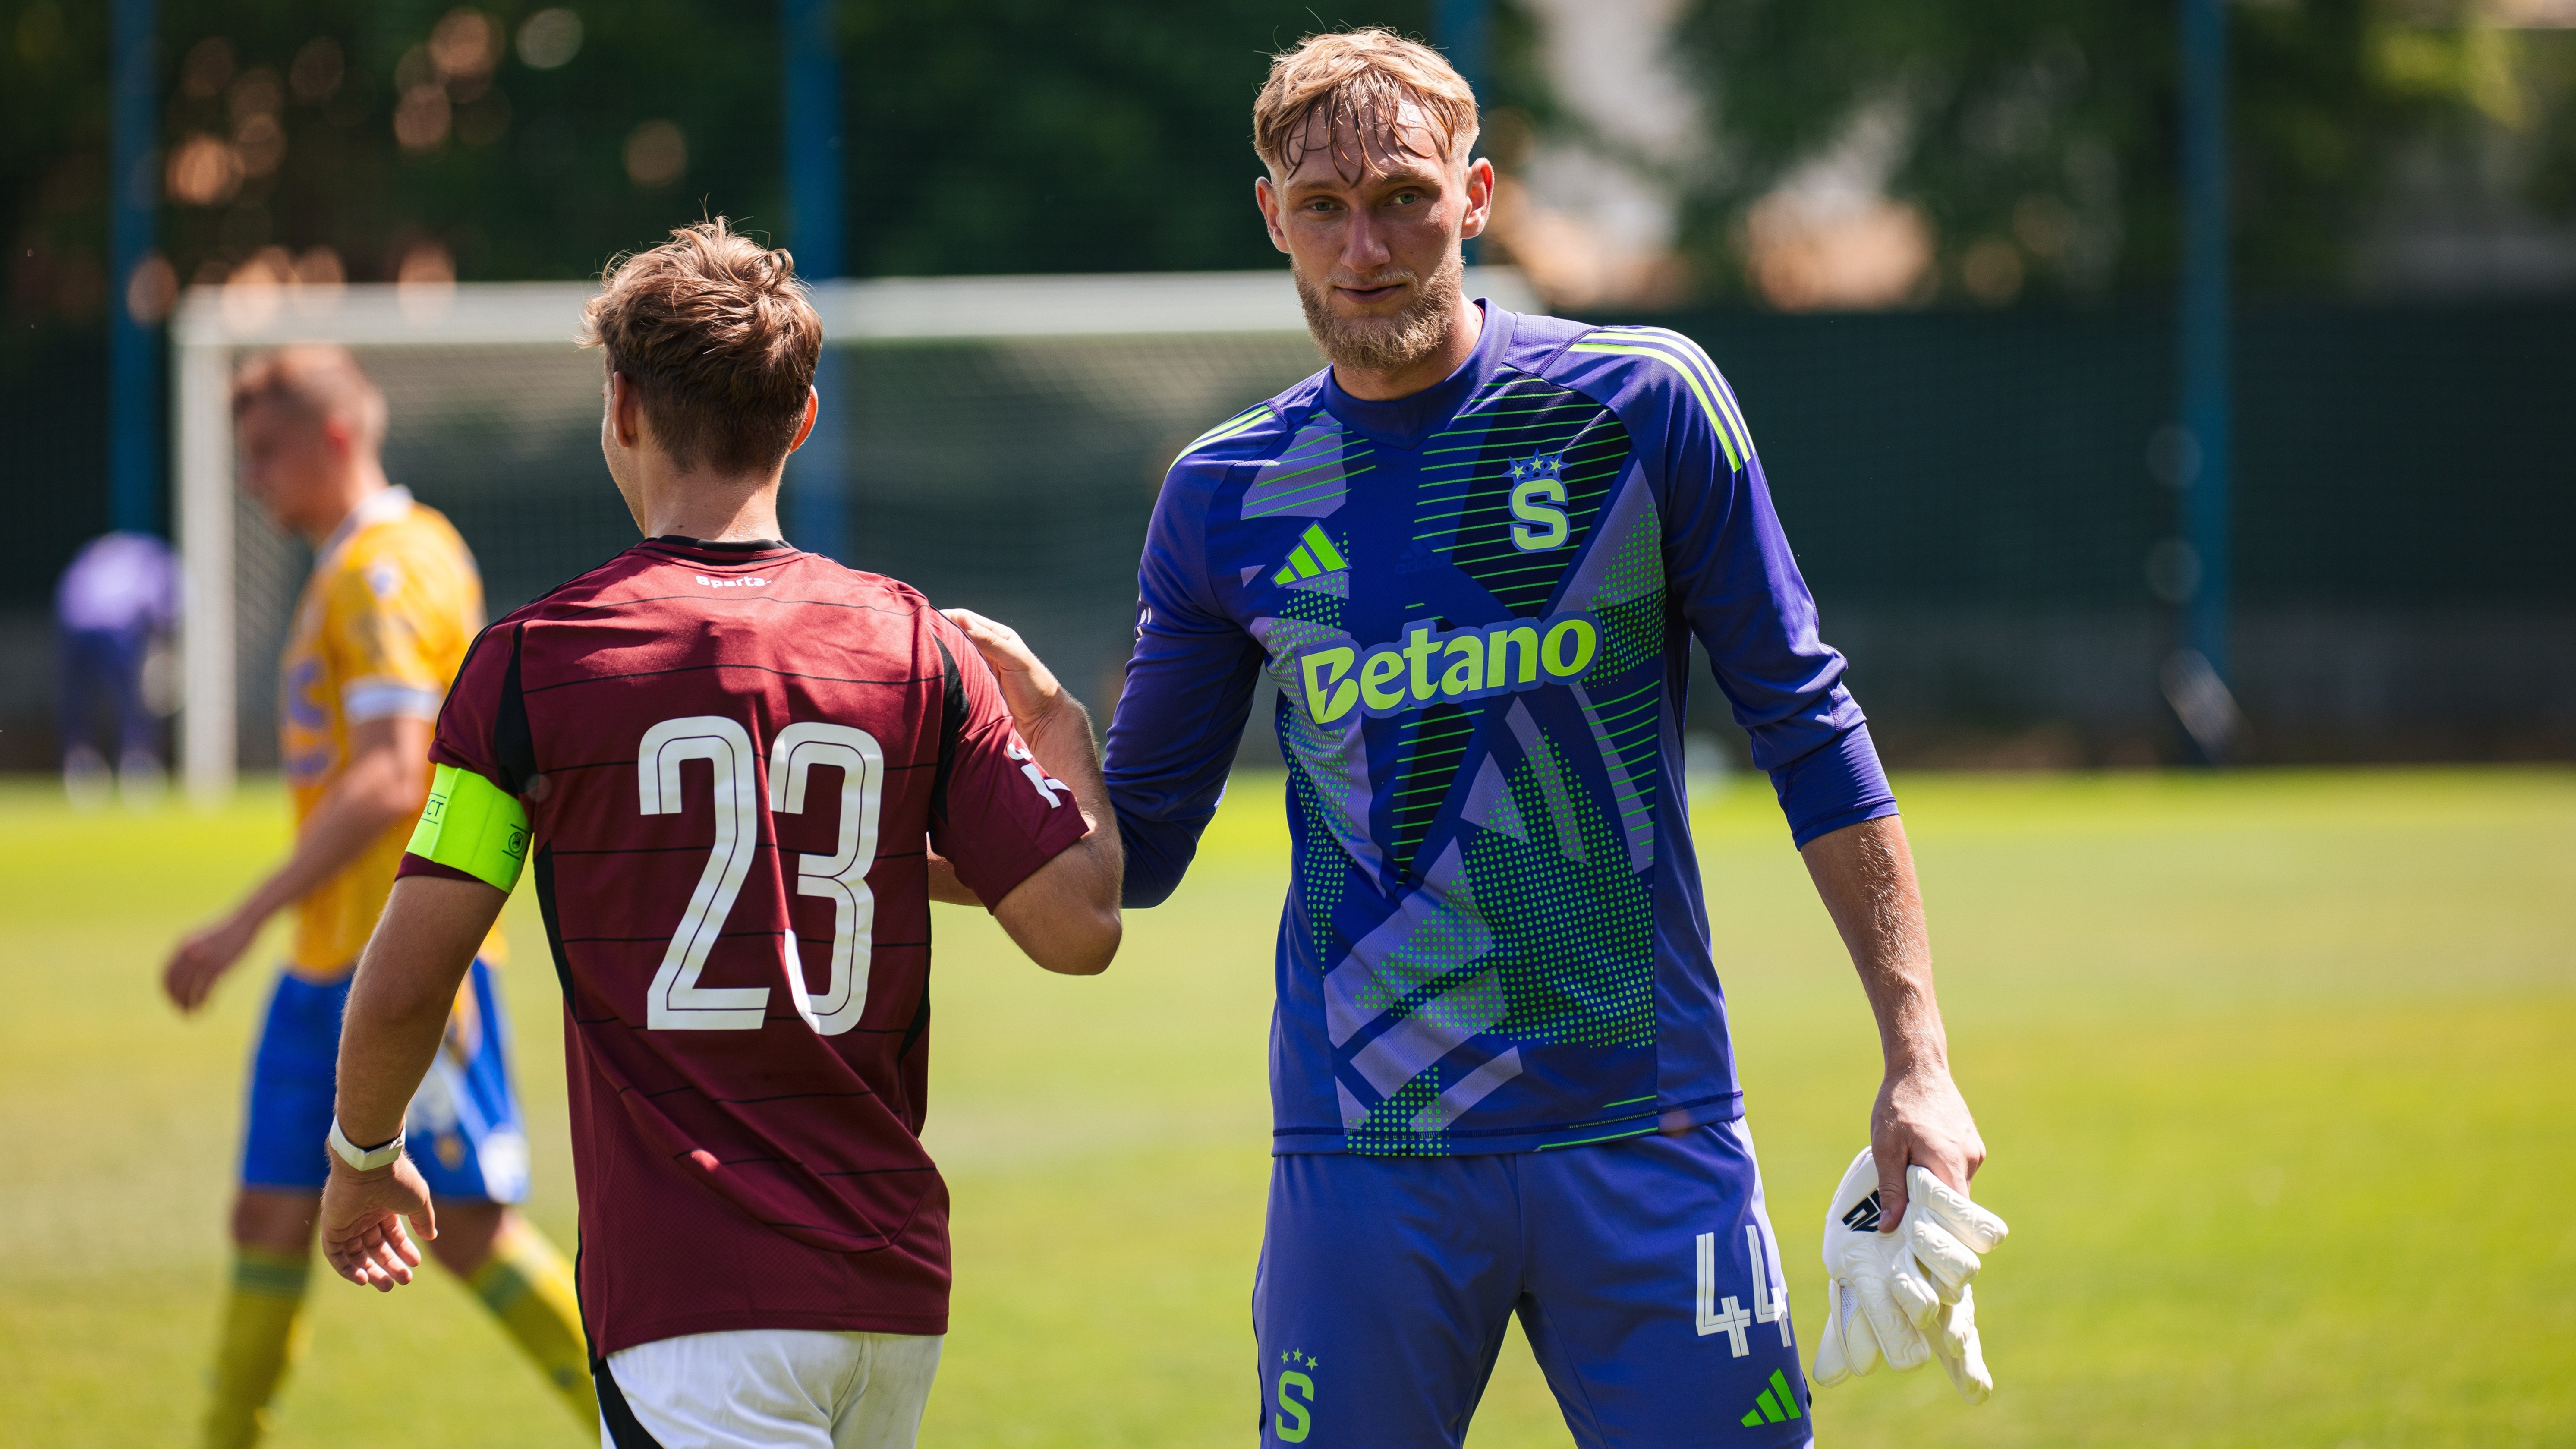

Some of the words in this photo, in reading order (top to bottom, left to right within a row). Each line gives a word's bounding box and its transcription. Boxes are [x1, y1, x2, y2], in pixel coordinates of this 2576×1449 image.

[1512, 479, 1568, 550] S
[1301, 619, 1596, 724] Betano
[423, 799, 444, 817] CT
[638, 715, 884, 1036] 23
[1696, 1225, 1792, 1358] 44
[1275, 1370, 1314, 1443] S
